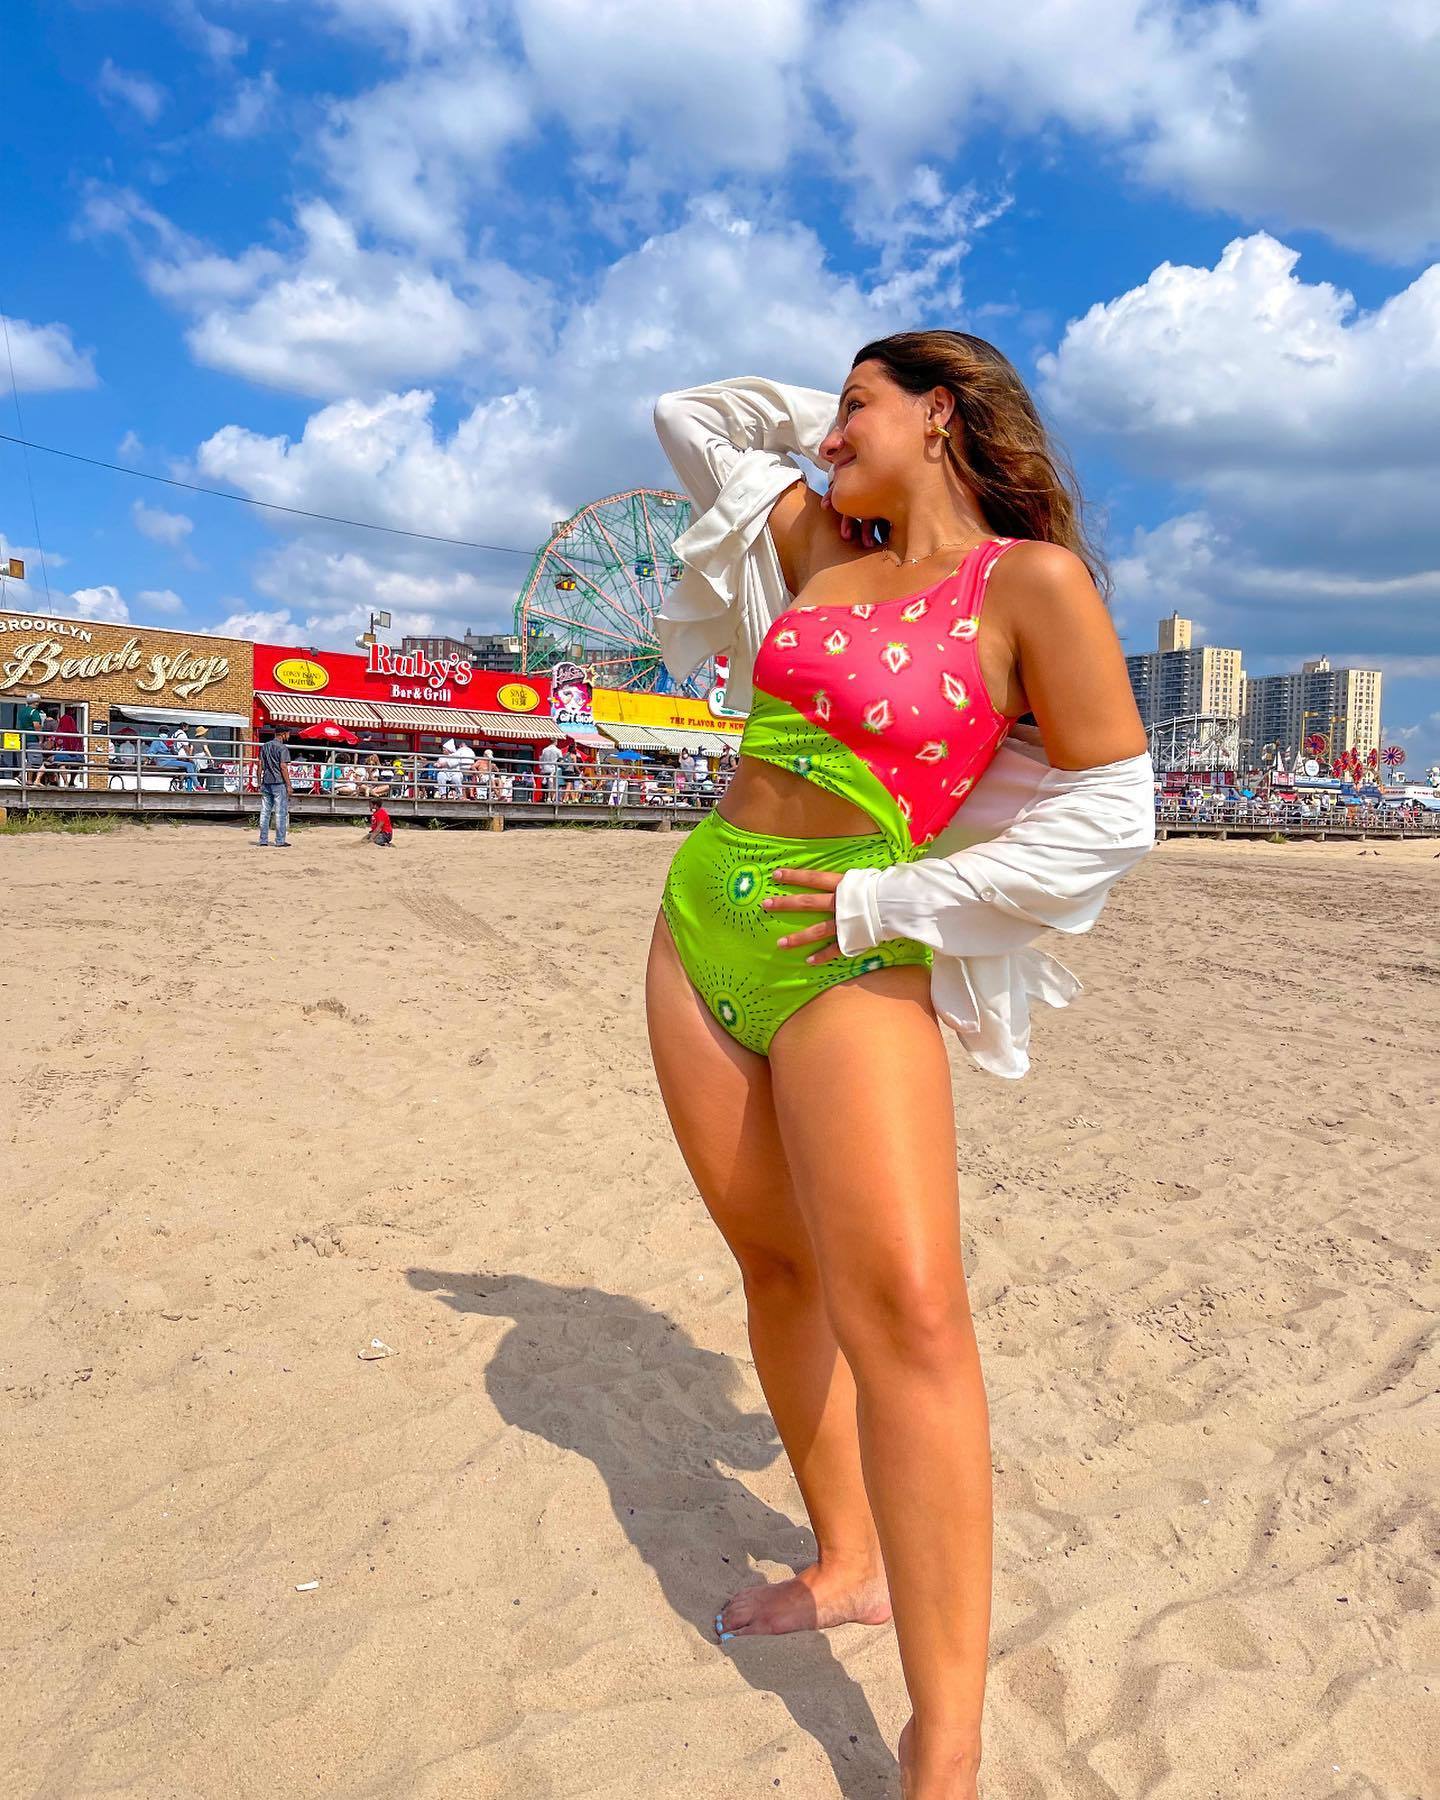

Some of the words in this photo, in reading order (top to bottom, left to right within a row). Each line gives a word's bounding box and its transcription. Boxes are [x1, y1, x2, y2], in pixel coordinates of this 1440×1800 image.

[0, 619, 92, 643] BROOKLYN
[0, 636, 142, 690] Beach
[135, 647, 229, 699] Shop
[364, 642, 472, 688] Ruby's
[391, 684, 412, 698] Bar
[423, 687, 451, 702] Grill
[670, 717, 684, 725] THE
[688, 718, 715, 728] FLAVOR
[717, 721, 727, 729] OF
